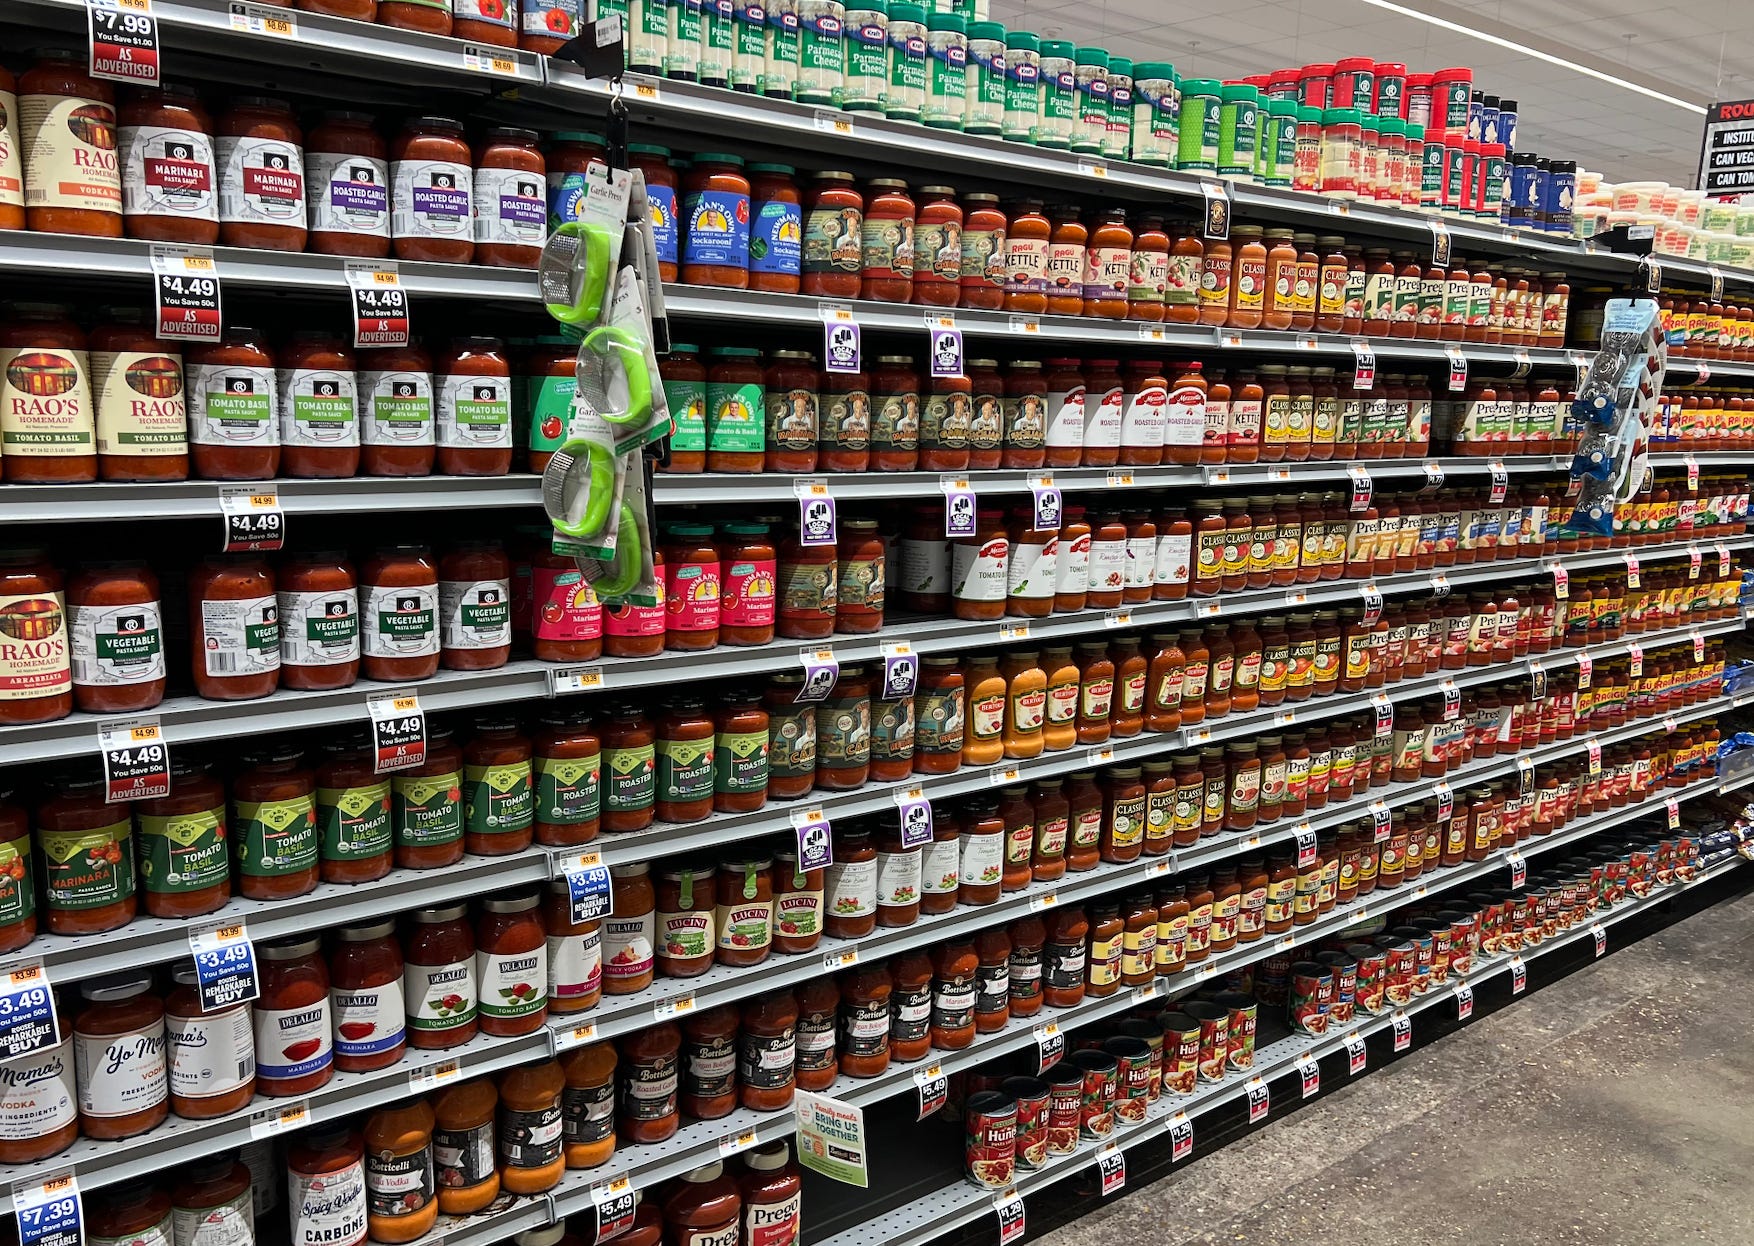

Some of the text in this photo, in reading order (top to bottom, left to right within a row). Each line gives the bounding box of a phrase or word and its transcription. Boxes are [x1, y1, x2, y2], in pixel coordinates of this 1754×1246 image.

[95, 10, 152, 35] $7.99
[820, 20, 838, 29] Kraft
[97, 31, 153, 47] You Save $1.00
[866, 29, 881, 37] Kraft
[119, 48, 132, 61] AS
[95, 59, 155, 78] ADVERTISED
[813, 55, 841, 69] Cheese
[860, 64, 886, 75] Cheese
[1020, 67, 1034, 76] Kraft
[1716, 153, 1735, 165] CAN
[155, 164, 204, 179] MARINARA
[254, 174, 297, 189] MARINARA
[1717, 173, 1735, 185] CAN
[333, 186, 366, 199] ROASTED
[415, 192, 447, 203] ROASTED
[502, 201, 530, 212] ROASTED
[690, 201, 736, 233] NEWMAN'S OWN
[1005, 255, 1039, 269] KETTLE
[1047, 259, 1079, 273] KETTLE
[162, 275, 215, 297] $4.49
[164, 296, 200, 306] You Save
[359, 290, 402, 308] $4.49
[184, 310, 196, 322] AS
[361, 309, 390, 317] You Save
[162, 321, 218, 335] ADVERTISED
[378, 320, 388, 331] AS
[360, 331, 406, 343] ADVERTISED
[832, 346, 854, 356] LOCAL
[11, 398, 79, 416] RAO'S
[209, 398, 268, 409] TOMATO BASIL
[297, 401, 332, 411] TOMATO
[376, 402, 410, 412] TOMATO
[458, 405, 490, 415] TOMATO
[744, 399, 755, 420] OWN
[19, 416, 74, 424] HOMEMADE
[15, 434, 80, 442] TOMATO BASIL
[710, 427, 757, 435] Tomato Basil
[232, 515, 279, 532] $4.49
[807, 521, 829, 530] LOCAL
[248, 533, 266, 541] Save
[468, 606, 506, 618] VEGETABLE
[315, 619, 355, 631] VEGETABLE
[386, 614, 429, 626] VEGETABLE
[105, 635, 155, 648] VEGETABLE
[0, 640, 64, 661] RAO'S
[9, 659, 60, 668] HOMEMADE
[135, 728, 155, 737] $4.99
[380, 718, 420, 734] $4.49
[381, 738, 393, 746] You
[110, 747, 162, 765] $4.49
[396, 745, 406, 757] AS
[379, 754, 422, 769] ADVERTISED
[738, 757, 767, 772] ROASTED
[113, 767, 148, 777] You Save
[679, 765, 710, 780] ROASTED
[133, 778, 145, 788] AS
[619, 773, 651, 788] ROASTED
[111, 785, 166, 799] ADVERTISED
[563, 785, 597, 800] ROASTED
[501, 791, 530, 808] TOMATO
[415, 805, 452, 822] TOMATO
[501, 803, 524, 816] BASIL
[352, 814, 386, 833] TOMATO
[415, 818, 443, 830] BASIL
[276, 828, 312, 848] TOMATO
[353, 828, 379, 841] BASIL
[183, 843, 221, 864] TOMATO
[276, 843, 304, 857] BASIL
[805, 846, 827, 857] LOCAL
[184, 858, 214, 872] BASIL
[54, 870, 110, 888] MARINARA
[571, 871, 605, 888] $3.49
[574, 897, 609, 912] REMARKABLE
[581, 905, 601, 918] BUY
[782, 899, 817, 910] LUCINI
[731, 909, 769, 921] LUCINI
[667, 918, 707, 929] LUCINI
[200, 946, 248, 967] $3.49
[500, 958, 538, 972] DELALLO
[15, 969, 36, 979] $3.99
[203, 966, 235, 979] You Save
[429, 970, 467, 983] DELALLO
[205, 977, 252, 998] REMARKABLE
[214, 988, 245, 1004] BUY
[12, 1013, 31, 1022] Save
[281, 1009, 321, 1027] DELALLO
[428, 1018, 454, 1027] TOMATO
[11, 1022, 35, 1033] ROUSES
[9, 1036, 42, 1054] BUY
[1041, 1038, 1062, 1053] $5.49
[105, 1044, 134, 1075] Yo
[288, 1060, 322, 1073] MARINARA
[641, 1066, 676, 1080] Botticelli
[923, 1079, 945, 1095] $5.49
[1249, 1086, 1267, 1101] $1.29
[5, 1106, 57, 1120] INGREDIENTS
[815, 1103, 857, 1121] Family meals
[815, 1112, 858, 1132] BRING US
[815, 1122, 858, 1143] TOGETHER
[1172, 1122, 1190, 1137] $1.29
[1102, 1155, 1121, 1169] $1.29
[302, 1199, 331, 1218] Spicy
[601, 1195, 632, 1215] $5.49
[754, 1199, 798, 1225] Prego
[1001, 1200, 1021, 1218] $1.29
[22, 1200, 75, 1225] $7.39
[25, 1224, 60, 1238] You Save
[305, 1216, 364, 1243] CARBONE
[764, 1223, 793, 1237] Traditional
